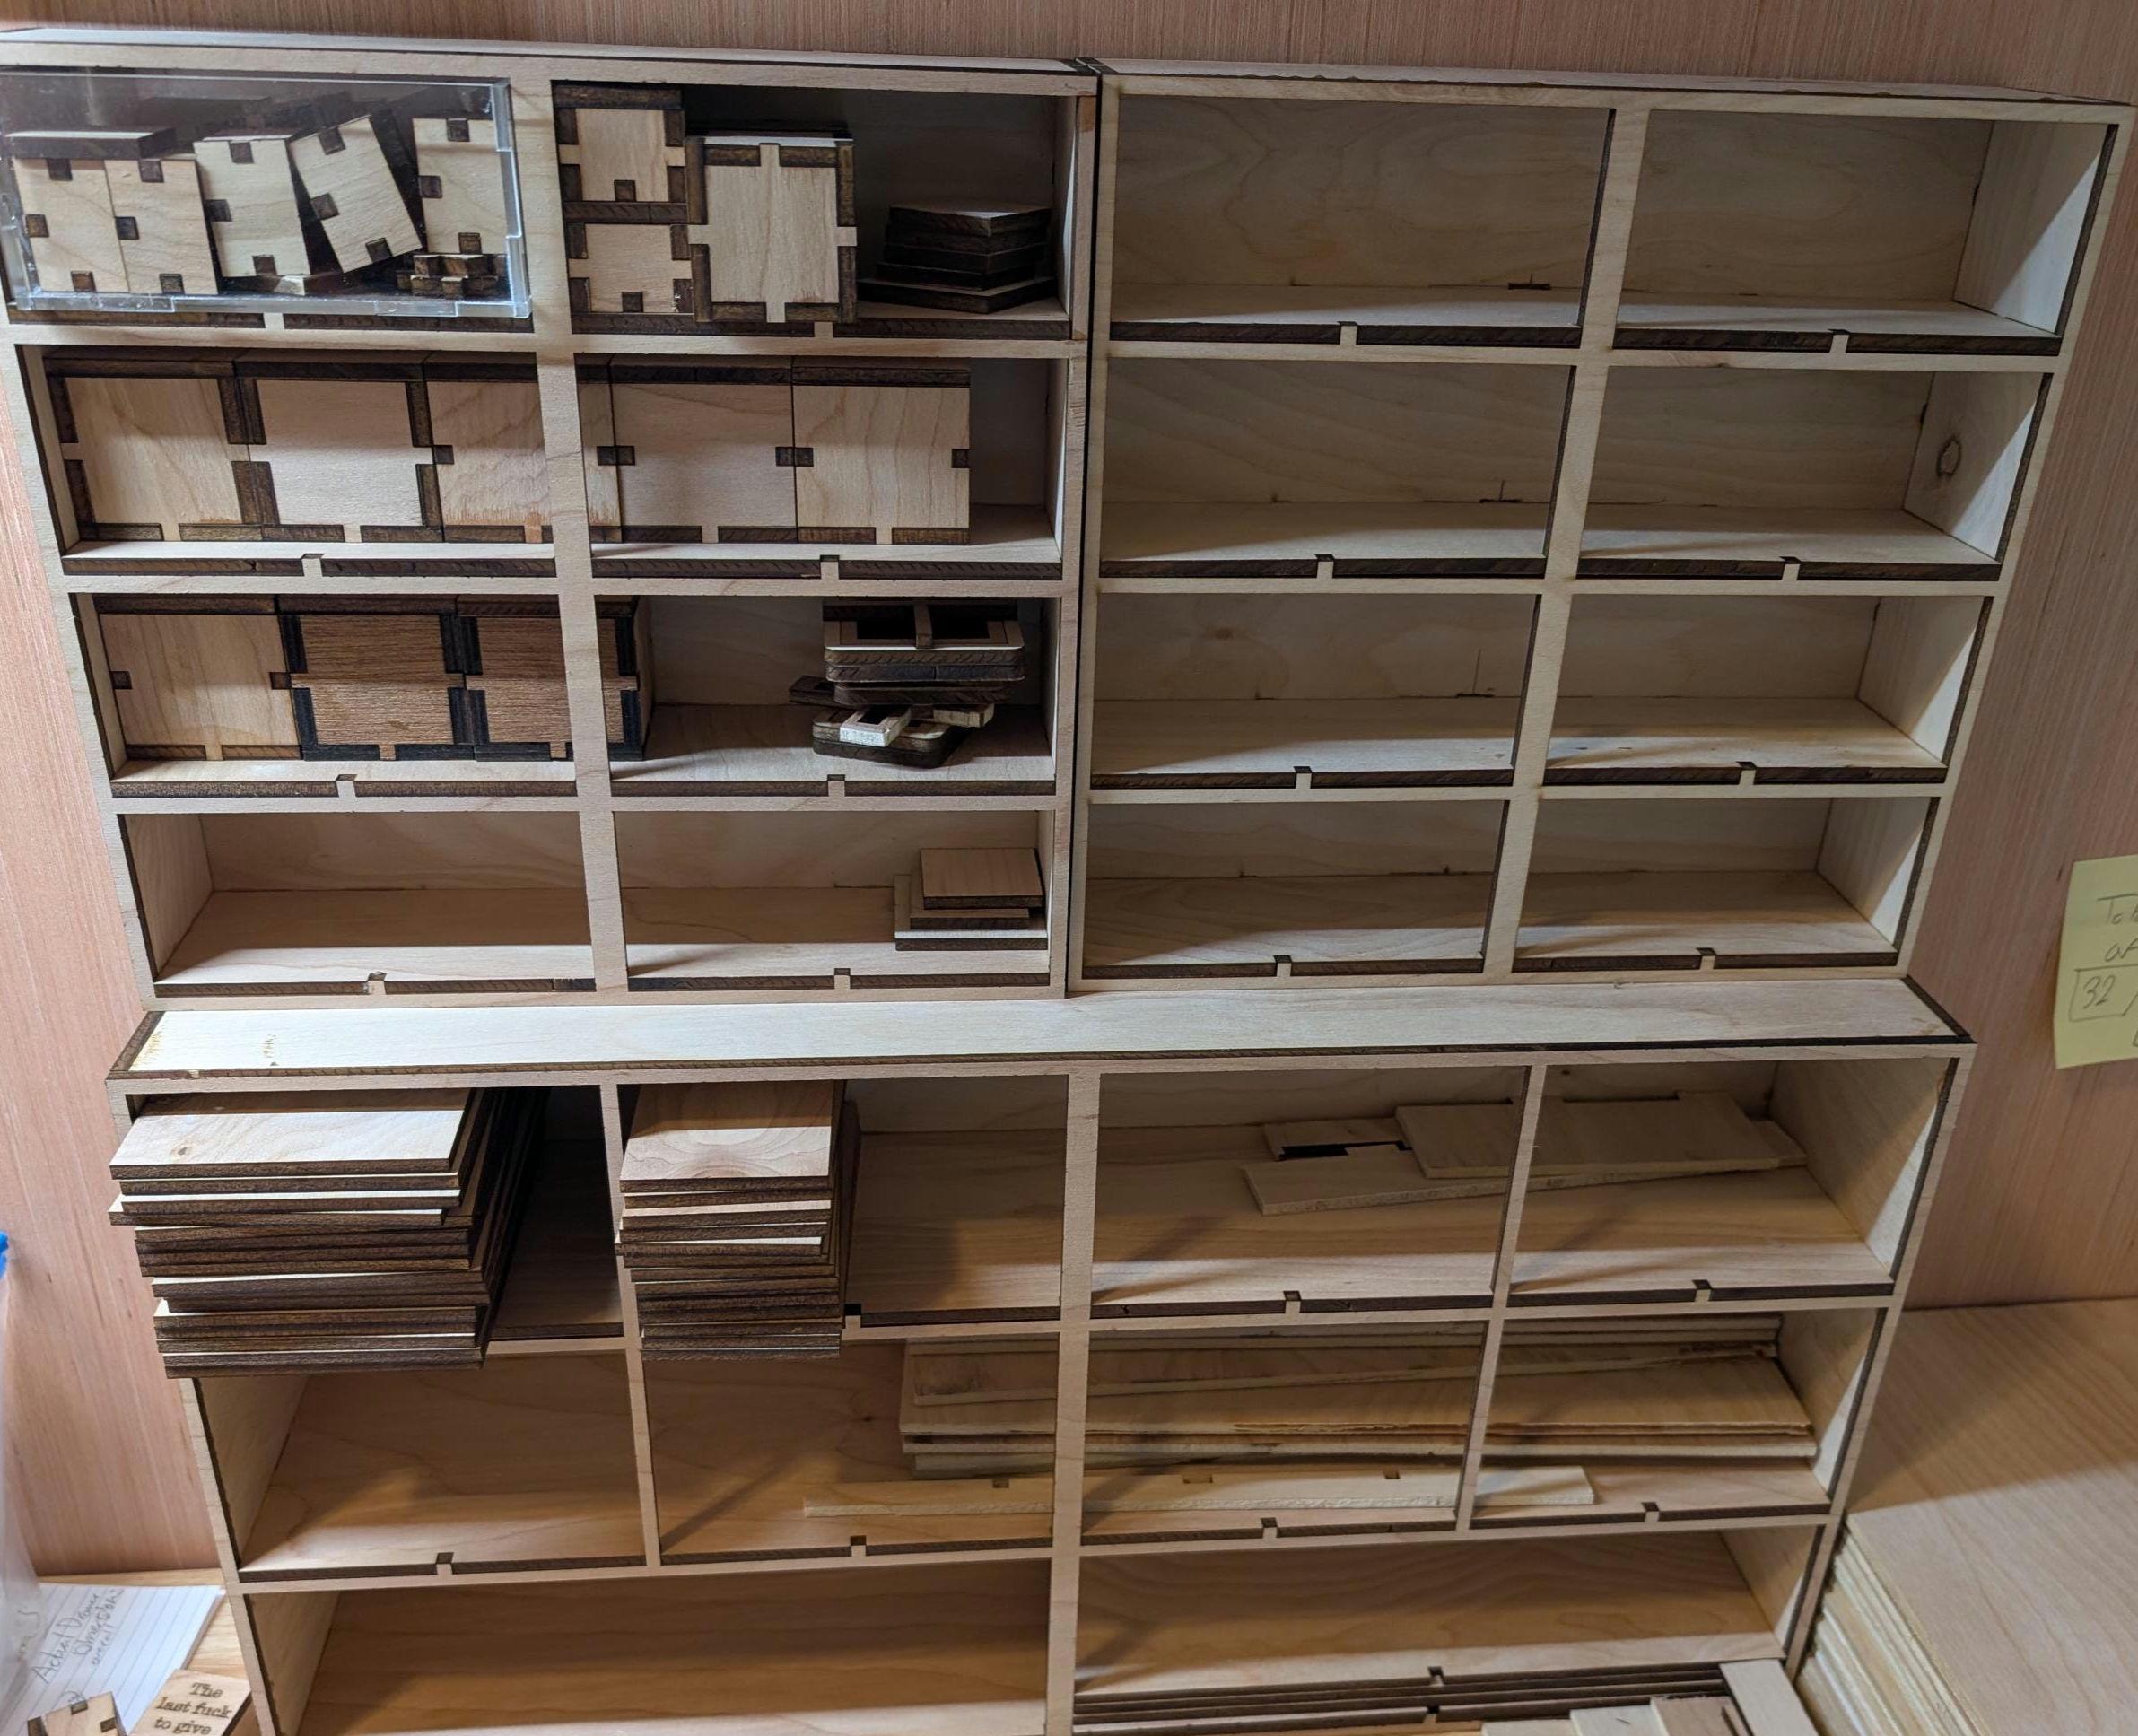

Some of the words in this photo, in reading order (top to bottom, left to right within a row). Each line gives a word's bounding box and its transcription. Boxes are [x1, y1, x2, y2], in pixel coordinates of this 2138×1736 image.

[2082, 973, 2116, 1010] 32
[31, 1630, 74, 1685] Actual
[189, 1681, 223, 1699] The
[155, 1696, 192, 1713] last
[192, 1702, 232, 1719] fuck
[153, 1716, 171, 1731] to
[172, 1719, 212, 1735] give
